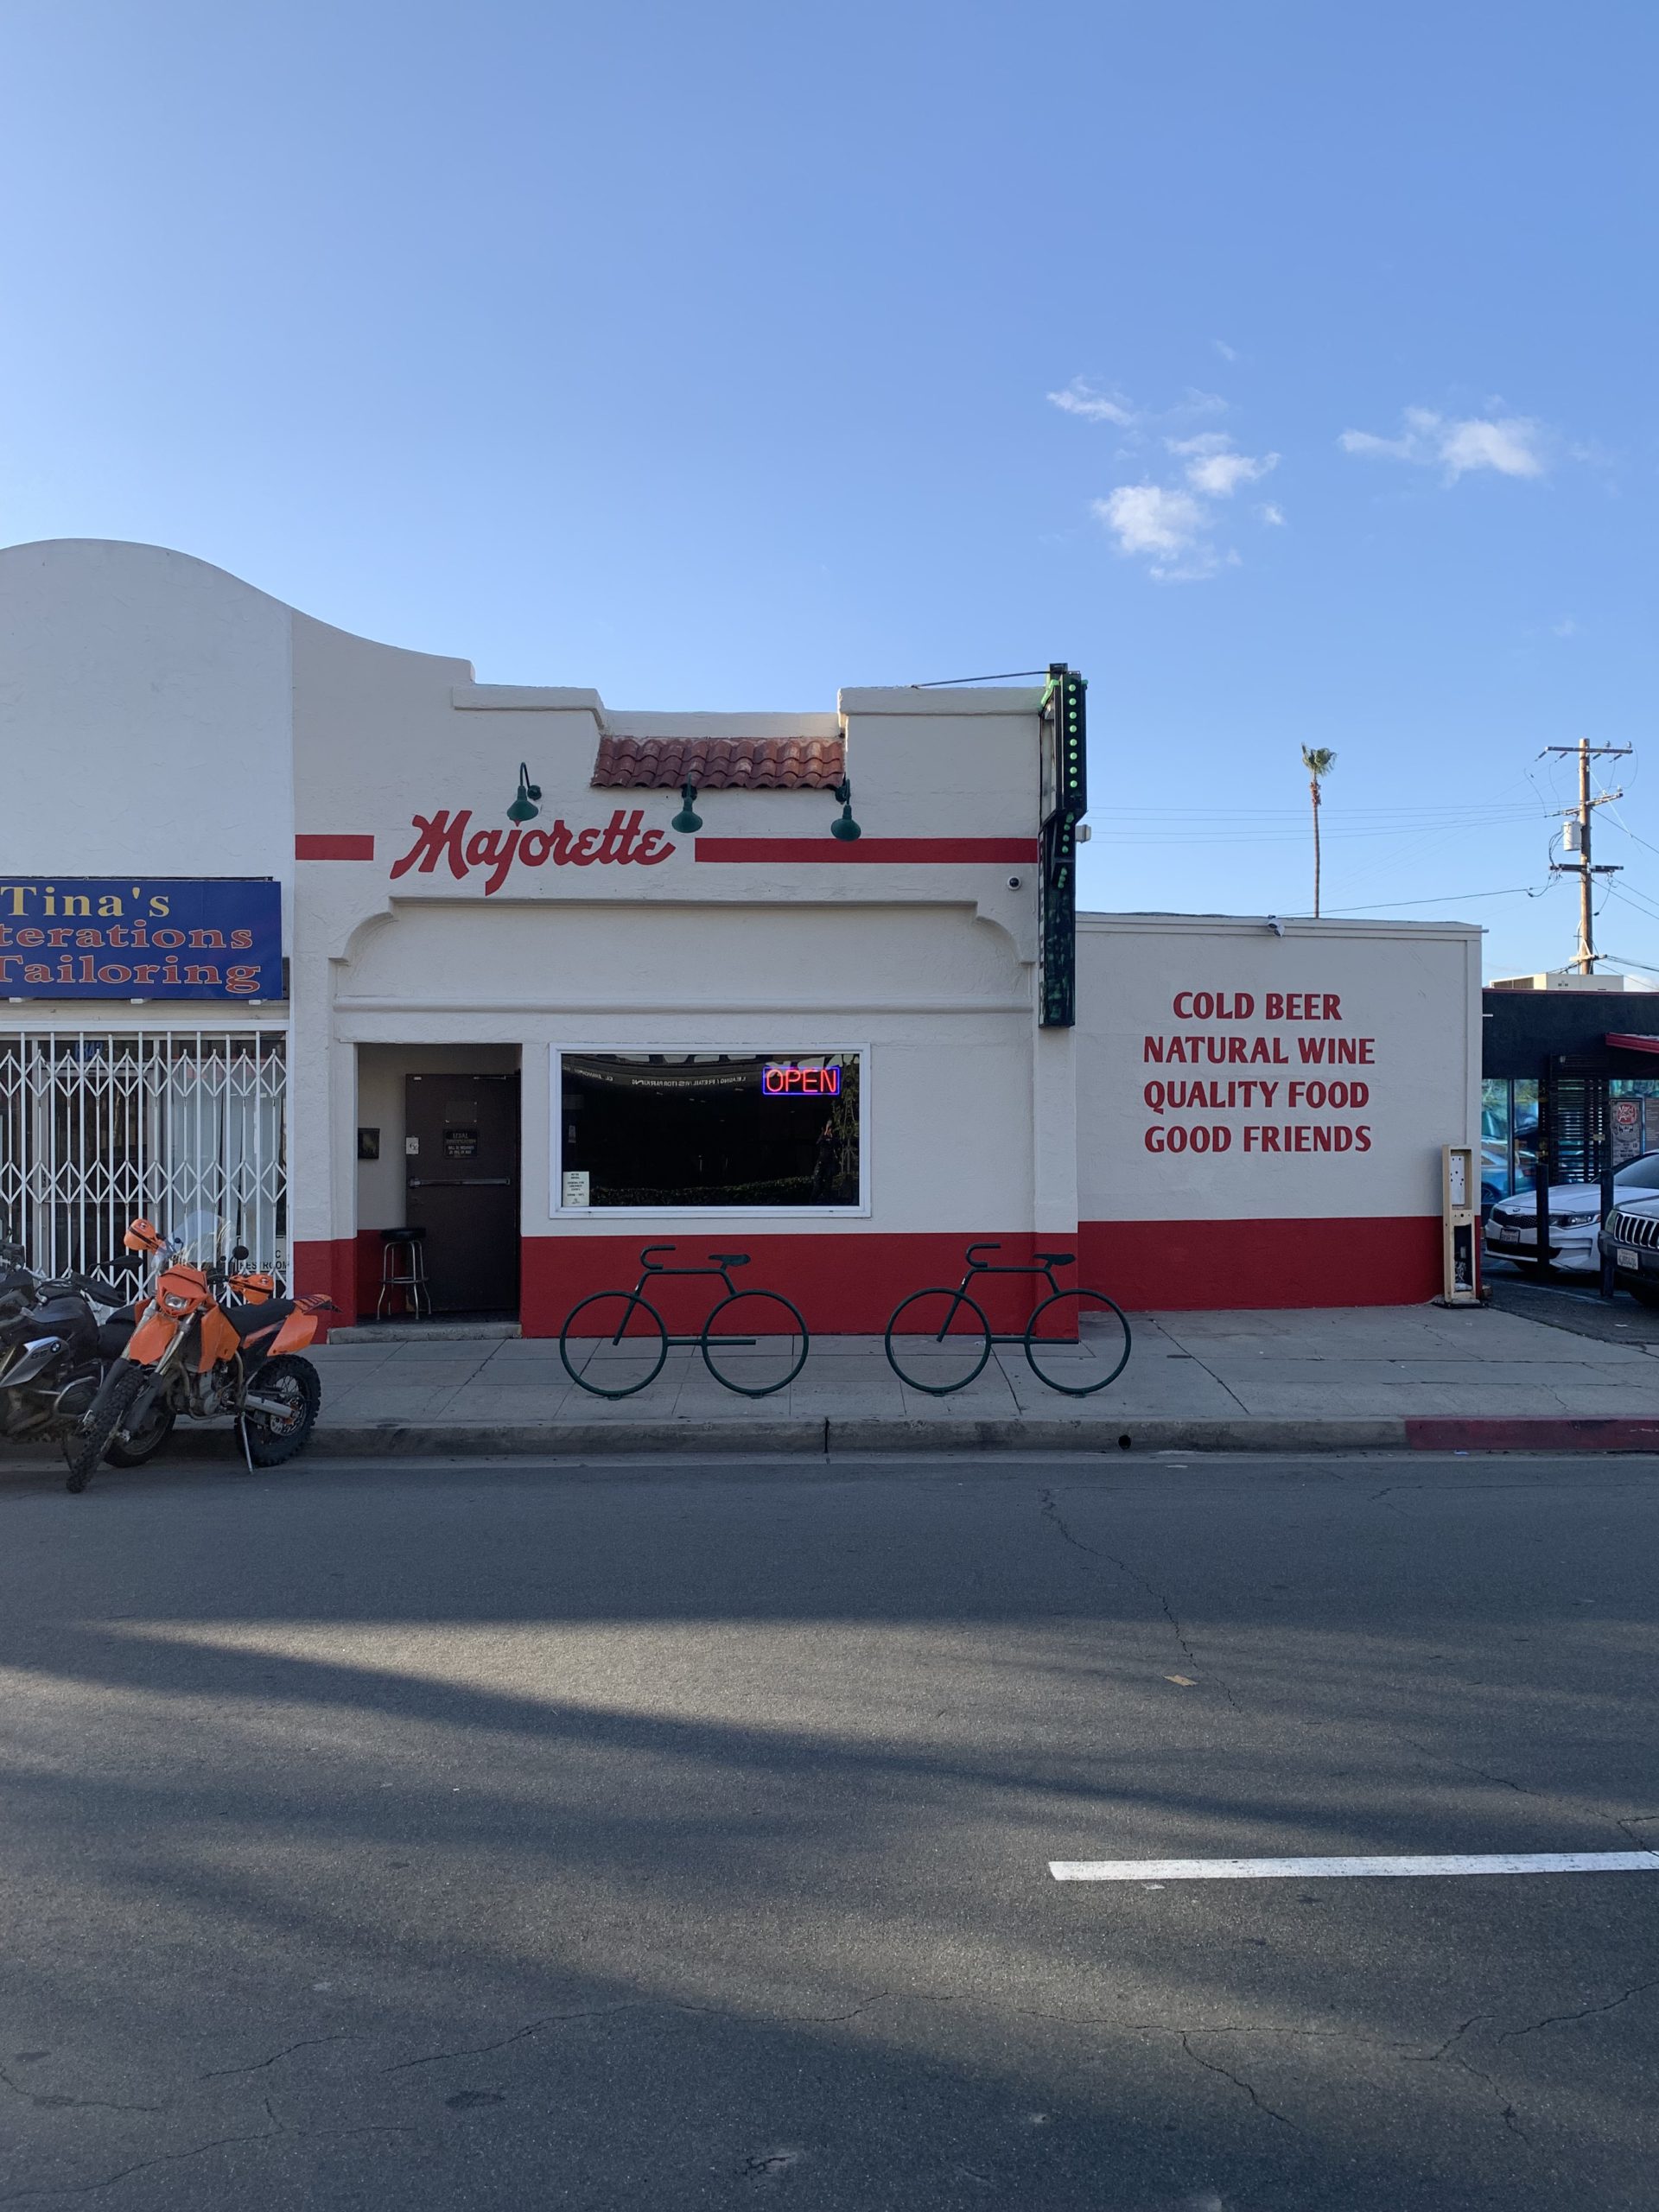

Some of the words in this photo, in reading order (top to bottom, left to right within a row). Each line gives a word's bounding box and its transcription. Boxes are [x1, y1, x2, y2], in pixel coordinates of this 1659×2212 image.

[390, 810, 676, 896] Majorette
[1, 887, 169, 918] Tina's
[1173, 992, 1255, 1020] COLD
[1266, 993, 1343, 1020] BEER
[1143, 1036, 1289, 1064] NATURAL
[1298, 1038, 1376, 1065] WINE
[766, 1069, 836, 1092] OPEN
[1143, 1081, 1279, 1115] QUALITY
[1288, 1082, 1370, 1109] FOOD
[1145, 1126, 1232, 1153] GOOD
[1243, 1126, 1372, 1153] FRIENDS
